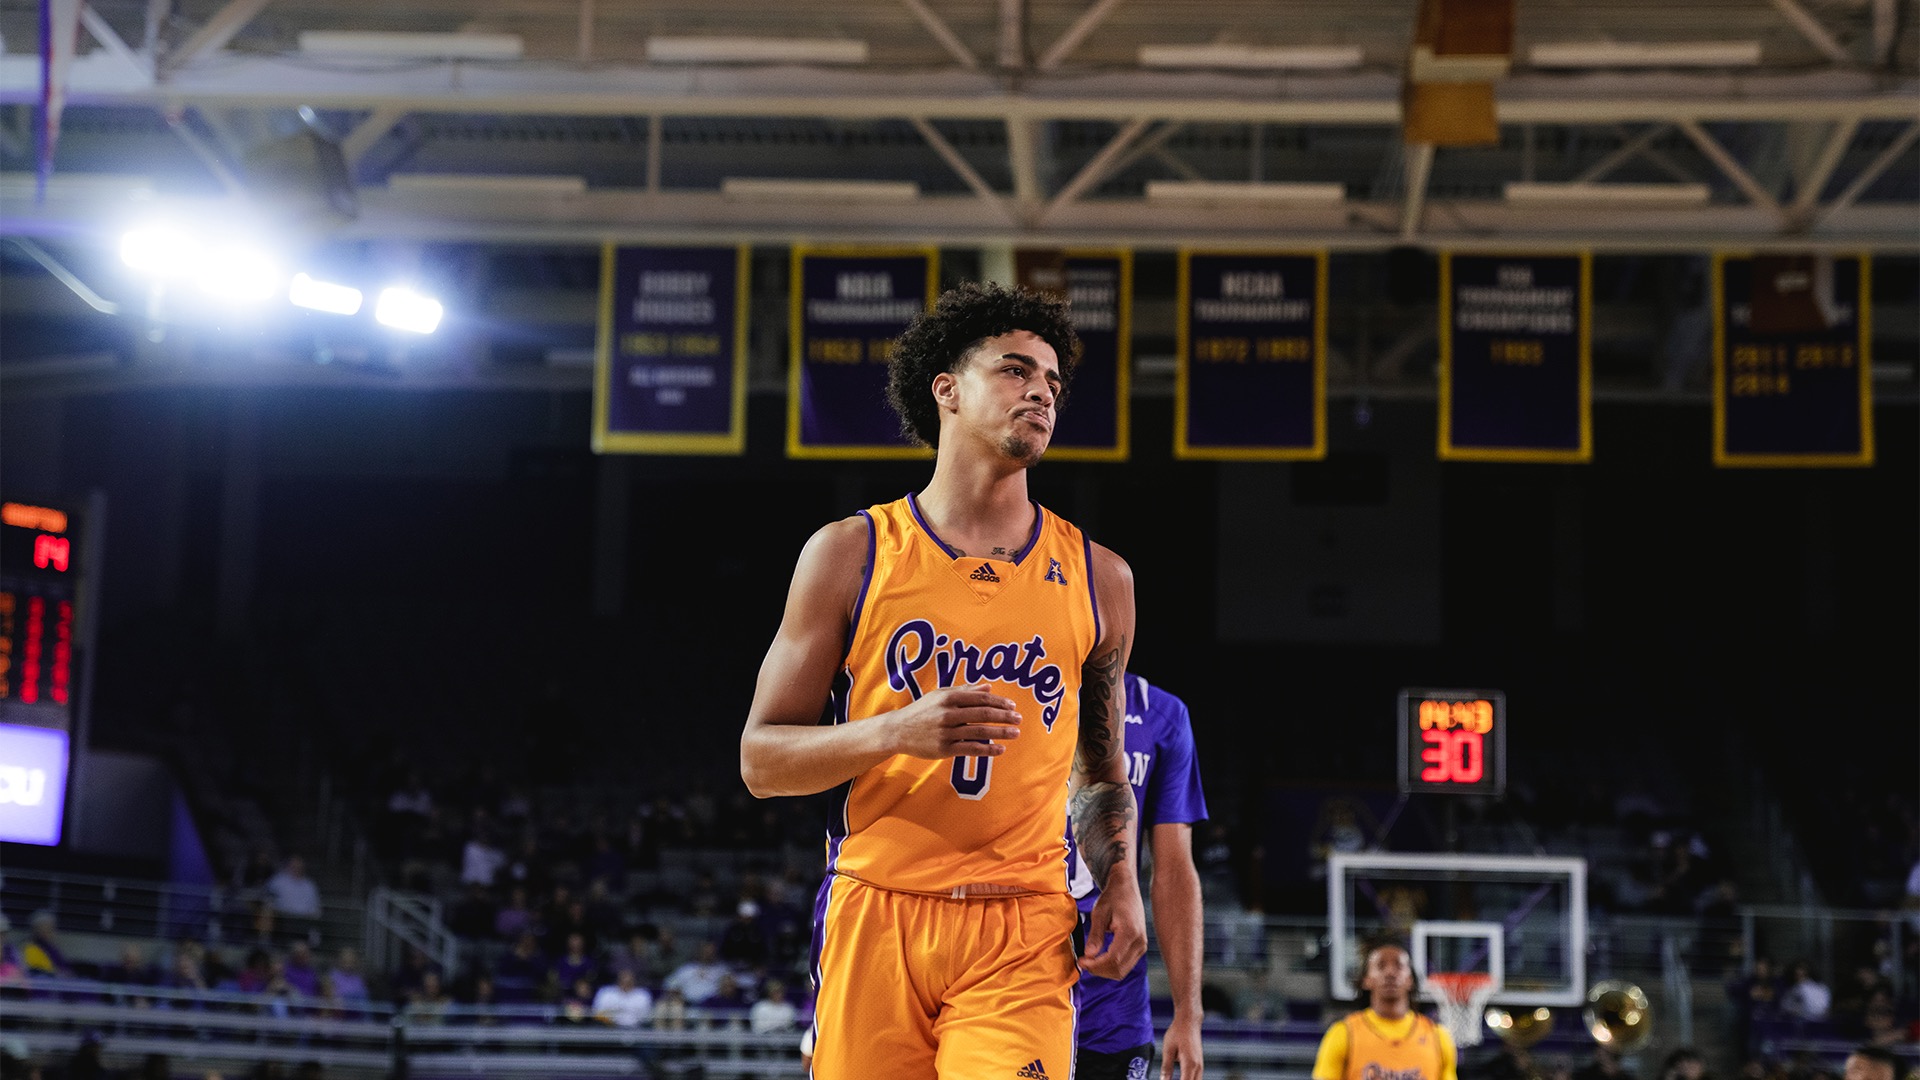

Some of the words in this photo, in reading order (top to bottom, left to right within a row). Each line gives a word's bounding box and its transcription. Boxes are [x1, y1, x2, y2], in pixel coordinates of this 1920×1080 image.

[970, 572, 1000, 583] adidas
[885, 618, 1066, 734] Pirates
[1421, 729, 1484, 784] 30
